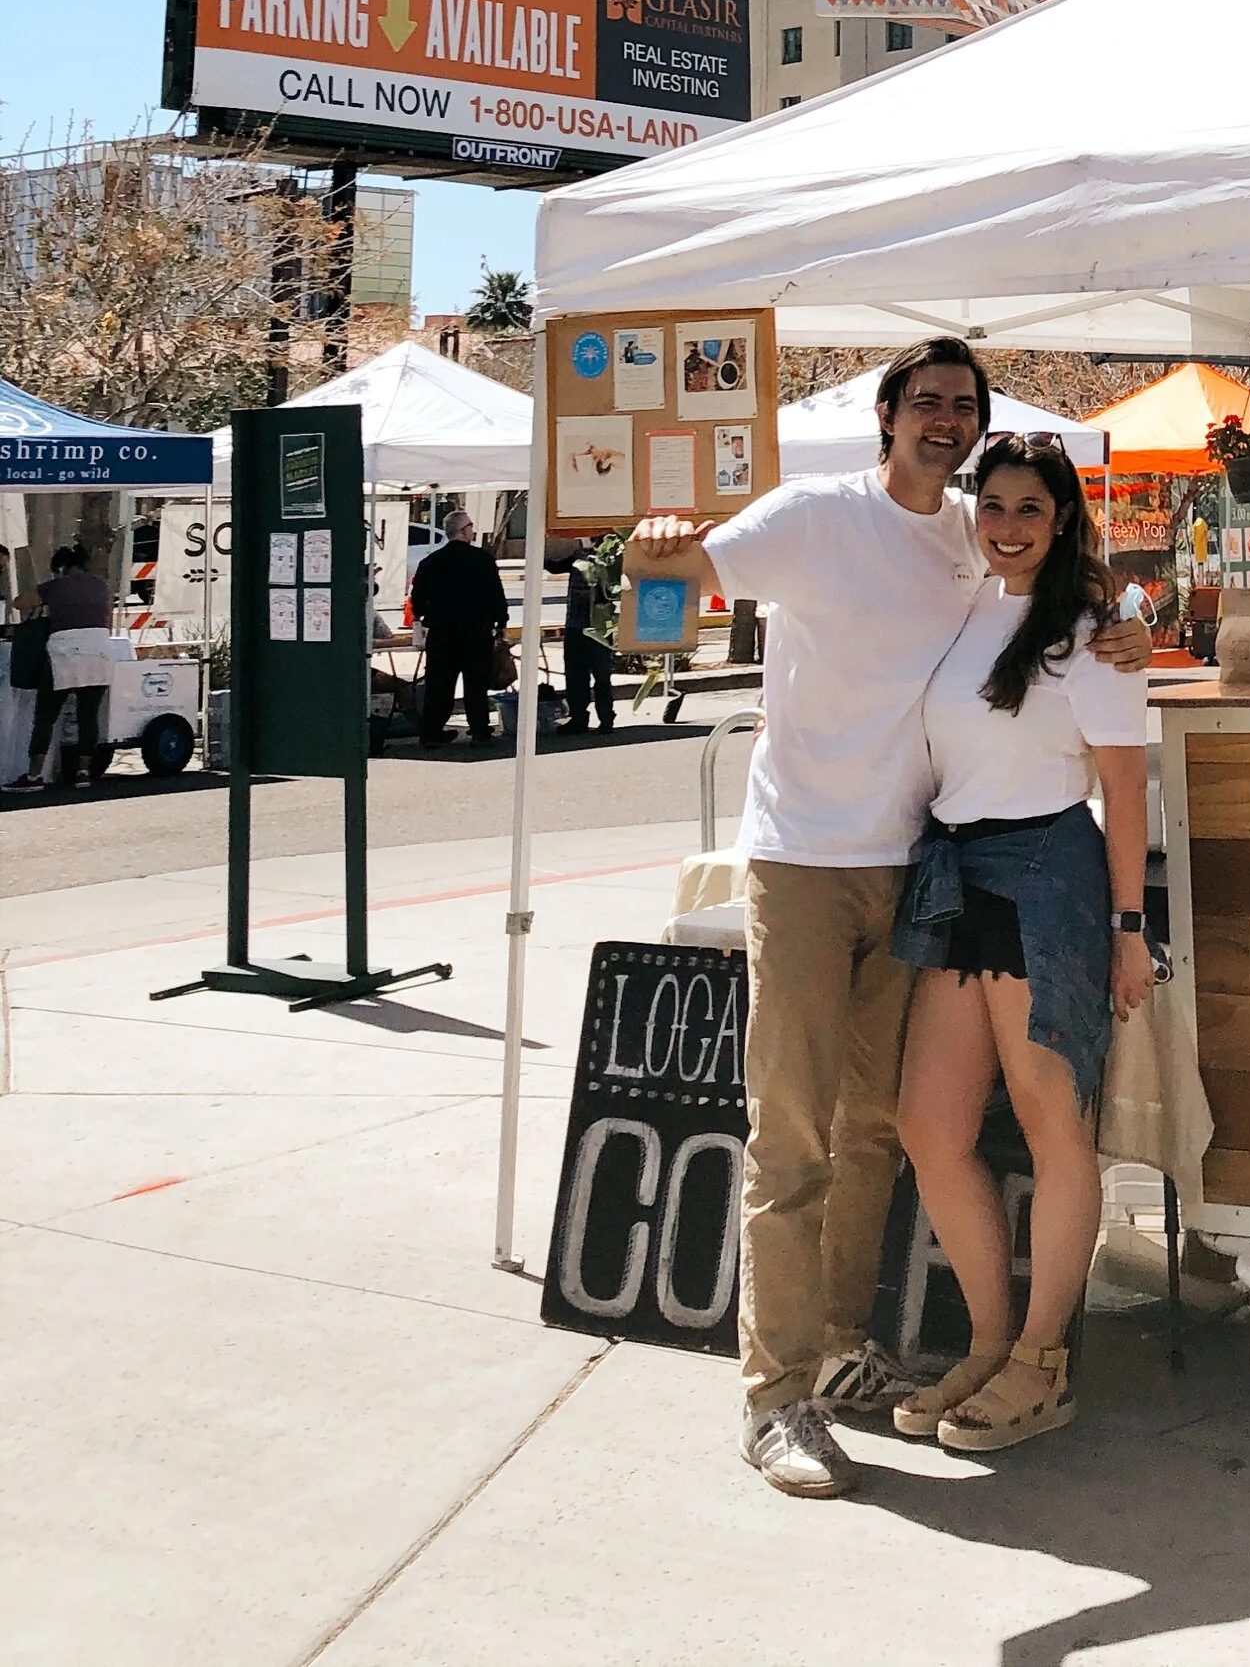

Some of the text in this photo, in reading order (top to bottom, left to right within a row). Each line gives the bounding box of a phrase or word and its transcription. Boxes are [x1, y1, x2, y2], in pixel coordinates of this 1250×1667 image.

[645, 15, 743, 43] CAPITAL PARTNERS
[623, 41, 728, 76] REAL ESTATE
[632, 67, 720, 98] INVESTING
[278, 68, 698, 149] CALL NOW 1-800-USA-LAND
[455, 139, 556, 168] OUTFRONT
[0, 438, 158, 465] shrimp co.
[7, 467, 42, 479] local
[58, 470, 75, 482] go
[80, 467, 110, 479] wild
[1142, 520, 1166, 542] Pop
[603, 972, 746, 1086] LOCA
